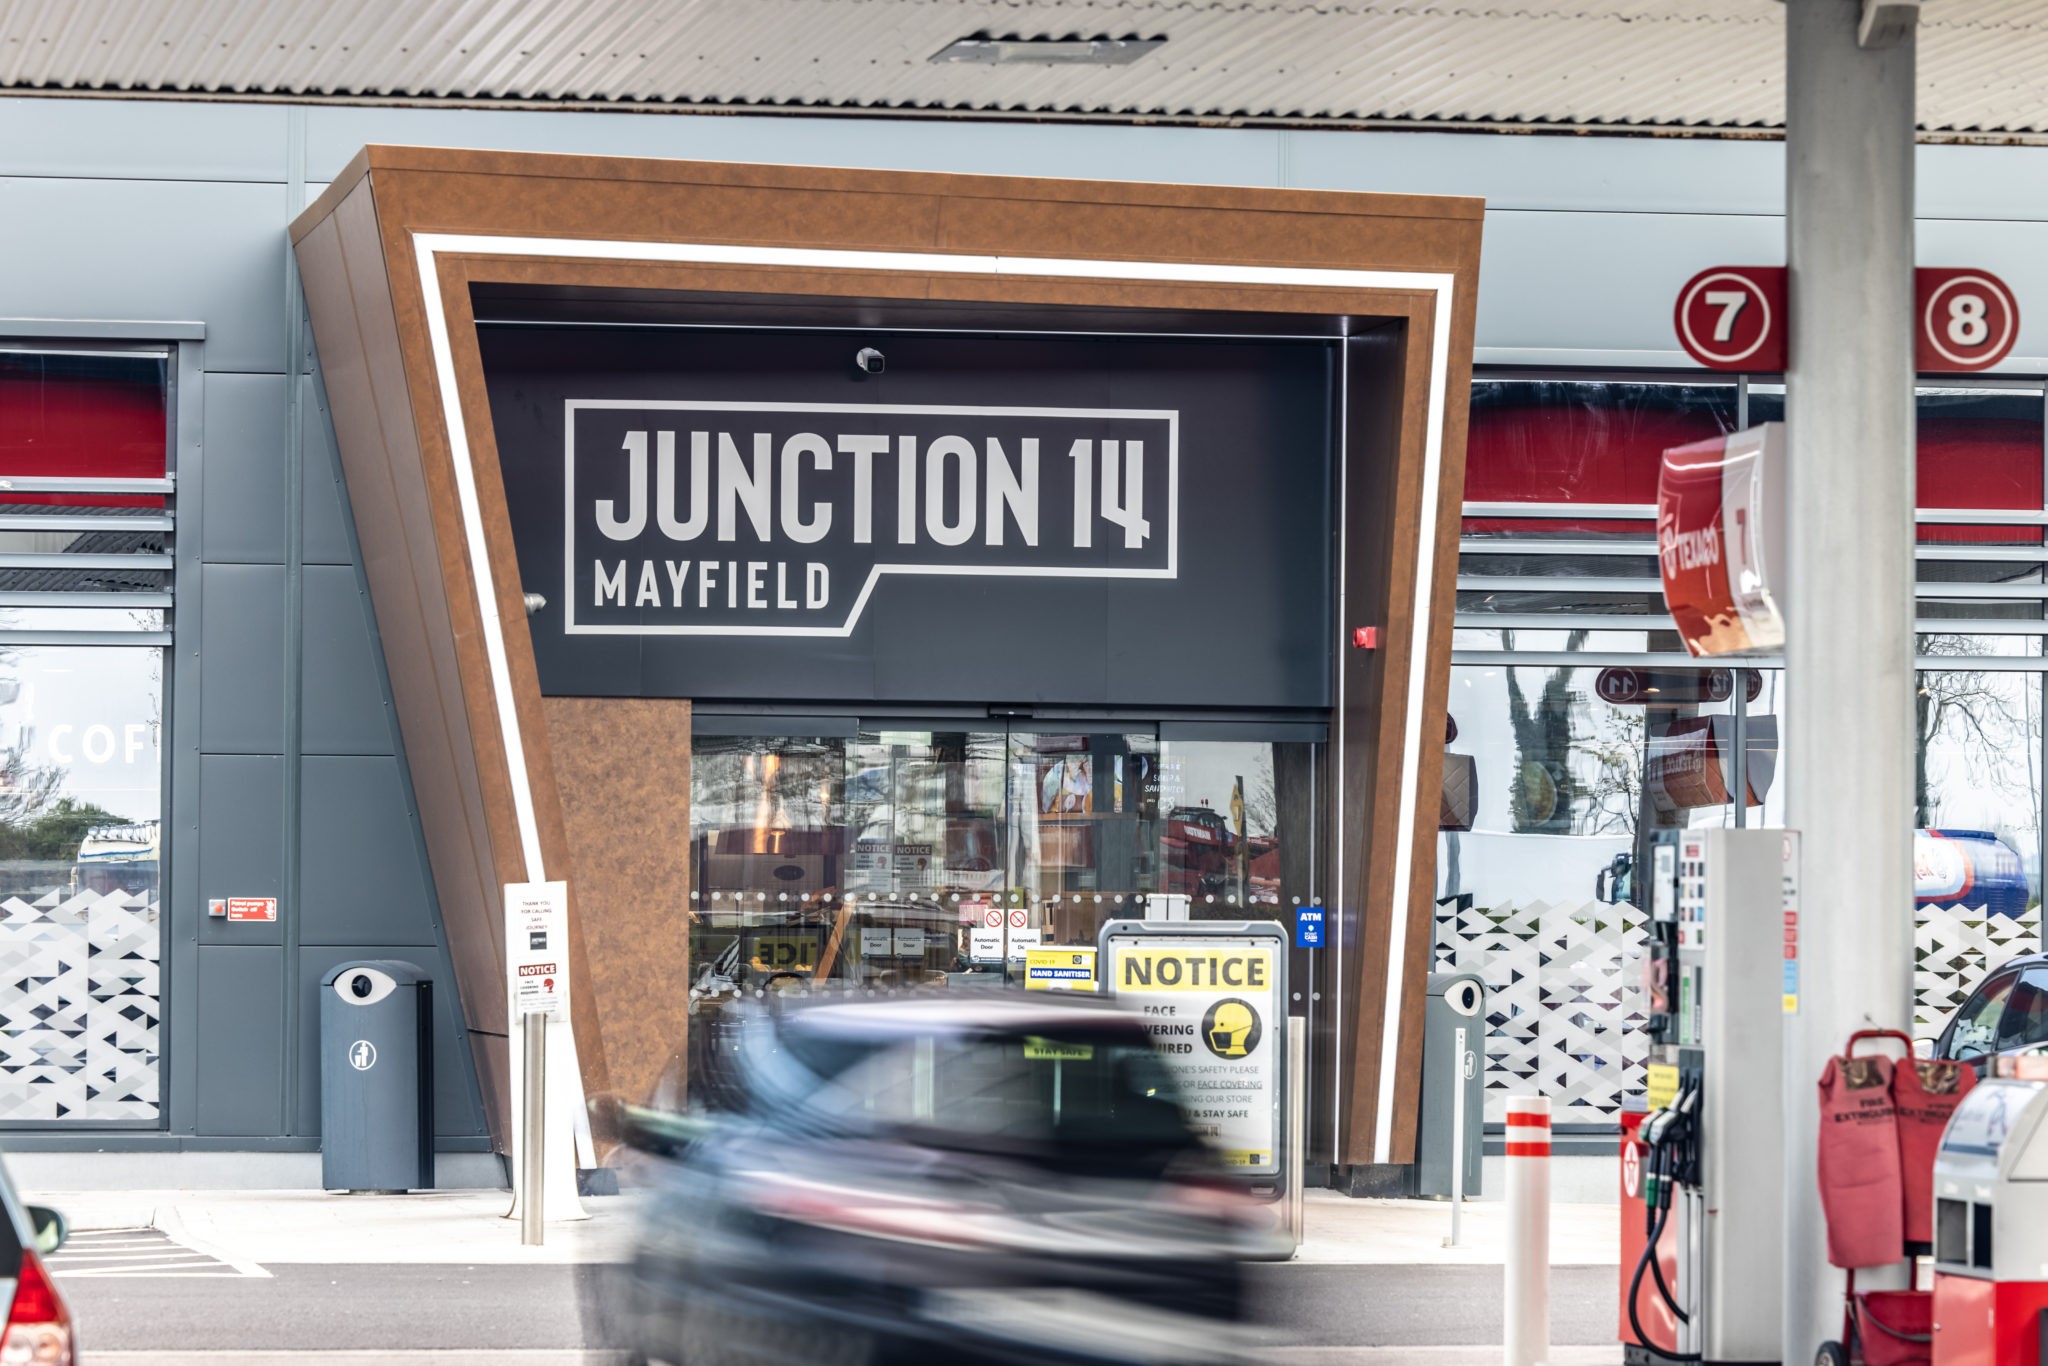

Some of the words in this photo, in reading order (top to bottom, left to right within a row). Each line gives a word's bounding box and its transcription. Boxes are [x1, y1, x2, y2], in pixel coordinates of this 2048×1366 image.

[1704, 291, 1748, 342] 7
[1947, 294, 1990, 346] 8
[595, 430, 1040, 548] JUNCTION
[1069, 439, 1150, 549] 14
[1735, 508, 1747, 565] 7
[1677, 526, 1720, 571] TEXACO
[594, 559, 830, 610] MAYFIELD
[48, 724, 161, 764] COF
[857, 844, 891, 853] NOTICE
[896, 846, 931, 855] NOTICE
[1300, 912, 1322, 922] ATM
[520, 965, 556, 976] NOTICE
[1031, 969, 1053, 977] HAND
[1054, 970, 1091, 978] SANITISER
[1124, 957, 1265, 987] NOTICE
[1143, 1005, 1176, 1016] FACE
[1143, 1024, 1195, 1036] VERING
[1198, 1065, 1228, 1074] SAFETY
[1230, 1065, 1260, 1074] PLEASE
[1183, 1080, 1196, 1088] OR
[1197, 1080, 1218, 1089] FACE
[1220, 1080, 1263, 1089] COVERING
[1205, 1095, 1225, 1104] OUR
[1226, 1095, 1253, 1104] STORE
[1193, 1110, 1202, 1118] &
[1203, 1110, 1225, 1118] STAY
[1227, 1109, 1249, 1118] SAFE
